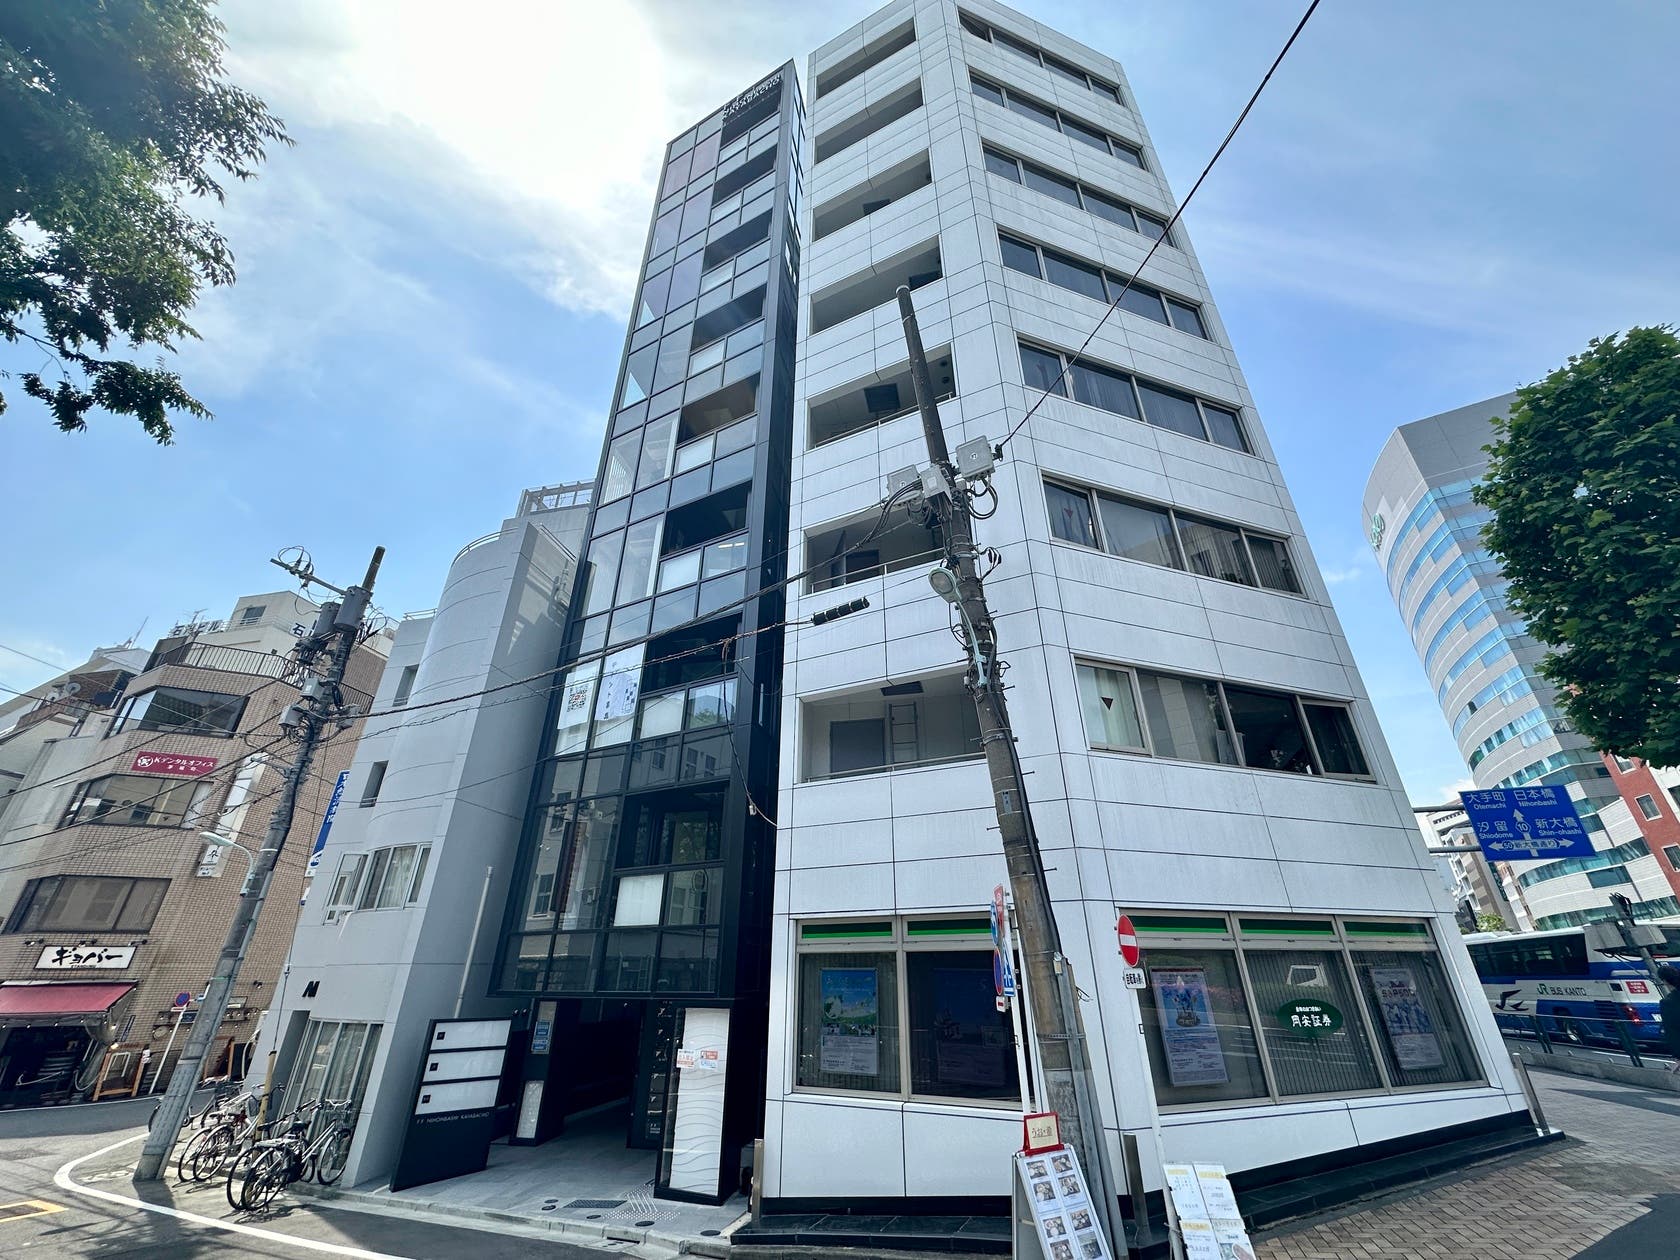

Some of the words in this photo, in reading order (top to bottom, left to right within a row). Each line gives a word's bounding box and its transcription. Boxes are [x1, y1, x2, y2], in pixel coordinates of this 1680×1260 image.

[1466, 791, 1506, 804] 大手町
[1514, 788, 1556, 800] 日本橋
[1477, 820, 1509, 832] 汐留
[1535, 817, 1578, 829] 新大橋
[1479, 832, 1514, 840] Shiodome
[1538, 828, 1583, 837] Shin-ohashi
[52, 946, 123, 966] ギョバー
[1537, 983, 1549, 996] JR
[1550, 987, 1563, 996] BUS
[1565, 986, 1587, 996] KANTO
